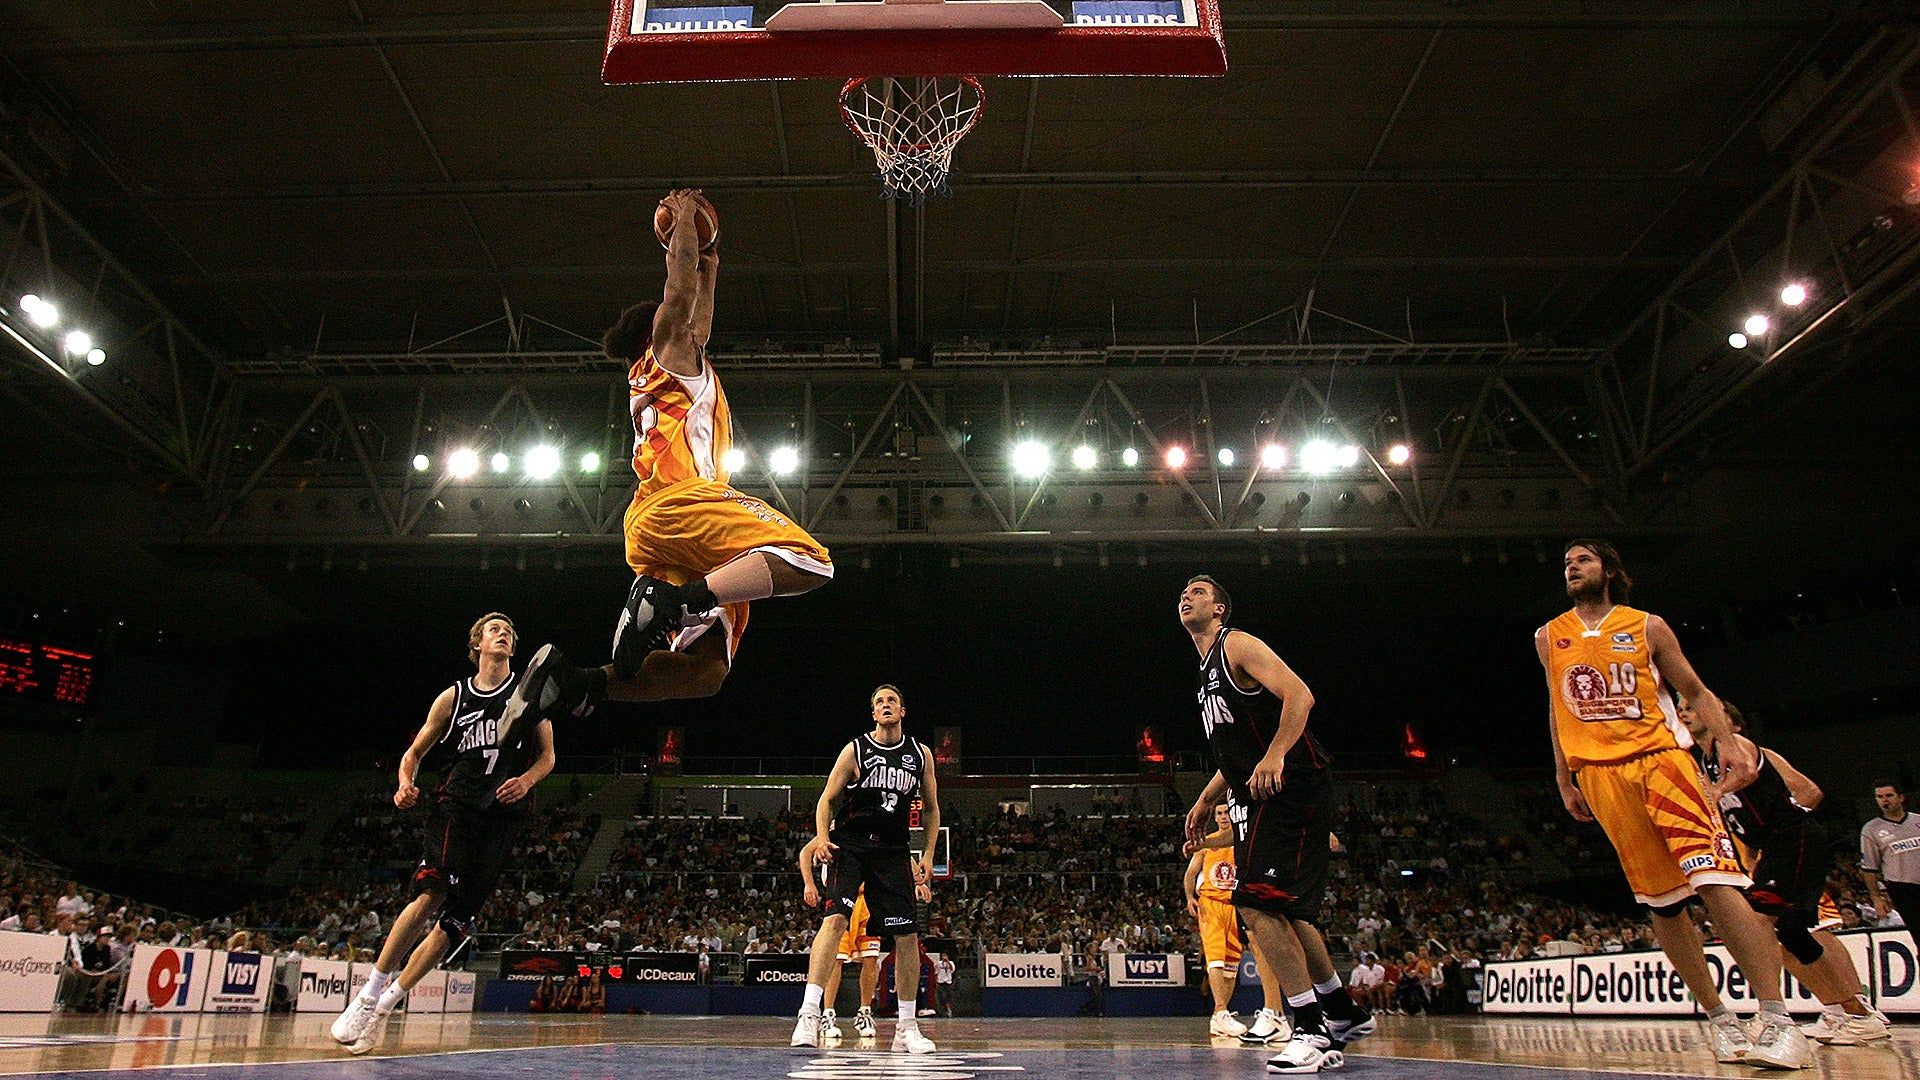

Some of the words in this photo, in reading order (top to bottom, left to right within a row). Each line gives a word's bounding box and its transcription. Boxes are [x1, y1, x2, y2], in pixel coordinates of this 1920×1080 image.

[1609, 662, 1636, 694] 10
[482, 748, 500, 775] 7
[227, 962, 258, 986] VISY
[636, 969, 696, 981] JCDecaux
[756, 970, 809, 982] JCDecau
[1127, 960, 1166, 974] VISY
[316, 974, 346, 999] nylex
[506, 974, 565, 982] DRAGNS
